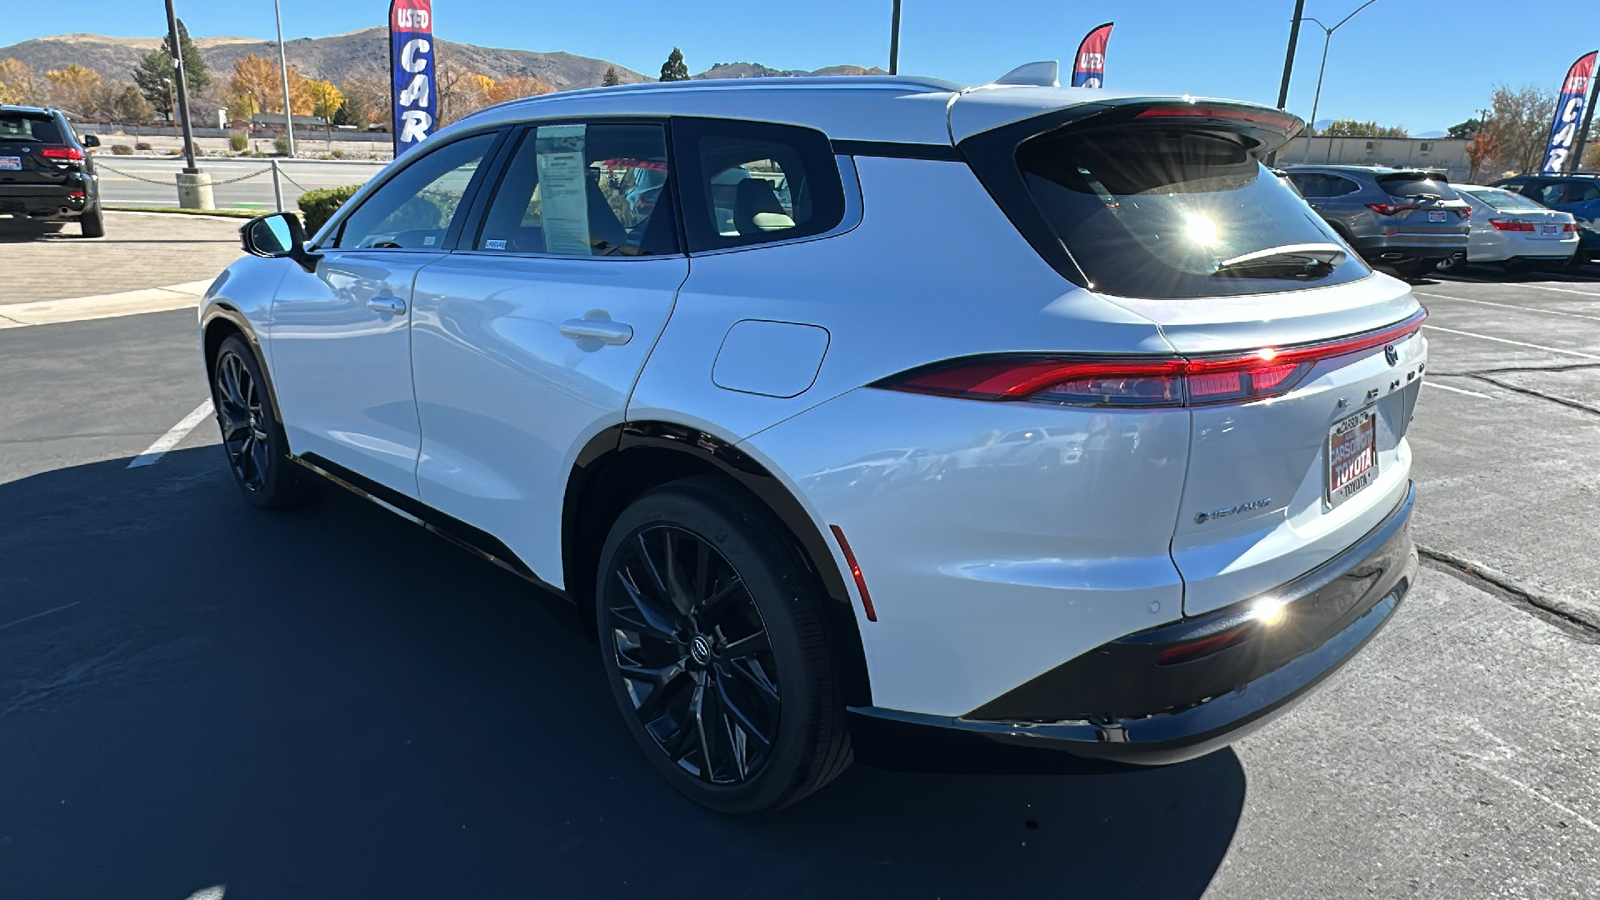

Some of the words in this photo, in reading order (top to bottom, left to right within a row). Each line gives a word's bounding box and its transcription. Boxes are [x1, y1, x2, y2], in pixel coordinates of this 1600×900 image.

[398, 8, 429, 29] USED
[400, 39, 432, 142] CAR
[1543, 97, 1583, 172] CAR
[1331, 436, 1359, 466] CARSON
[1335, 447, 1372, 487] TOYOTA
[1344, 473, 1368, 497] TOYOTA
